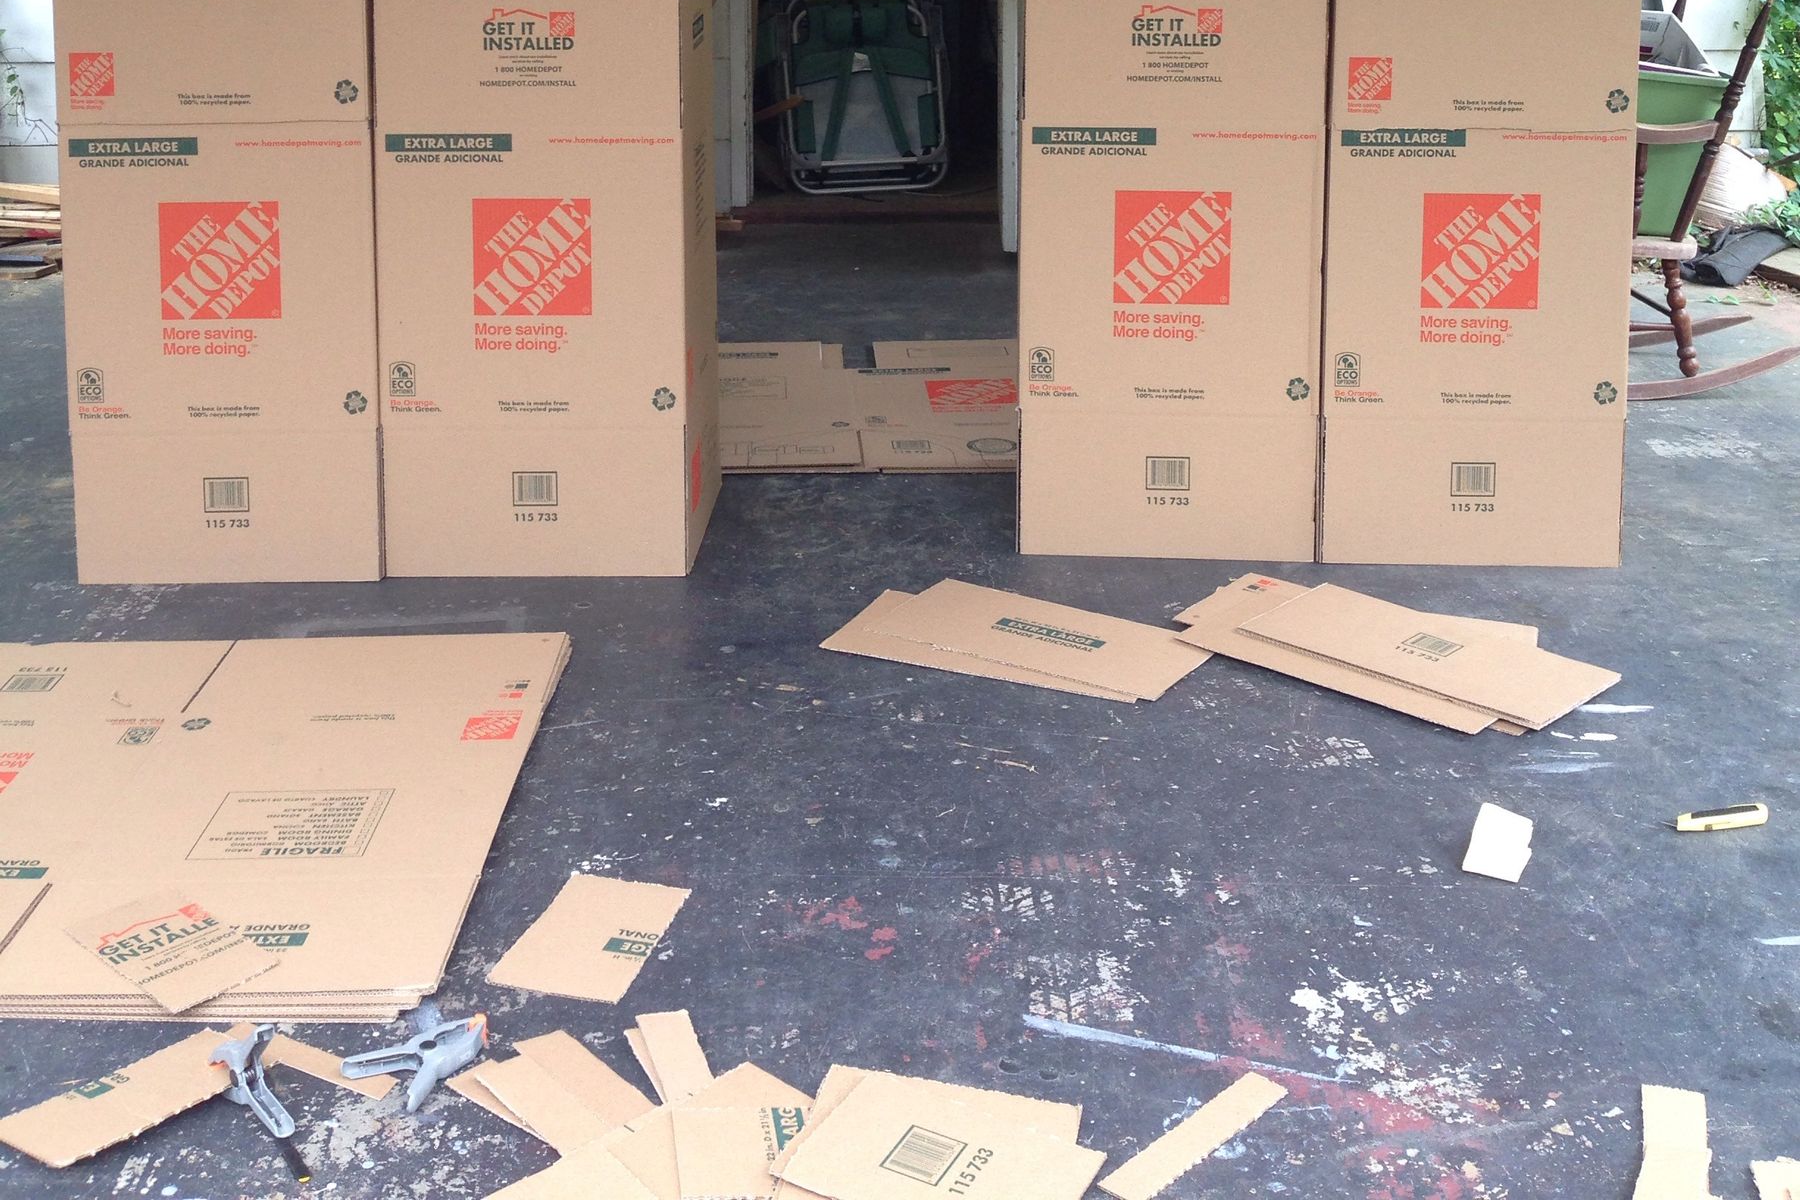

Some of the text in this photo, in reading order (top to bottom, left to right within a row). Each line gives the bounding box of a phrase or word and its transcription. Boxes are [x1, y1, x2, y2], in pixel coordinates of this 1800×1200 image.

[483, 22, 534, 35] GET IT
[1132, 19, 1183, 31] GET IT
[483, 38, 574, 50] INSTALLED
[1132, 34, 1221, 46] INSTALLED
[405, 138, 492, 149] EXTRA LARGE
[1051, 131, 1137, 142] EXTRA LARGE
[1360, 133, 1447, 143] EXTRA LARGE
[89, 141, 178, 153] EXTRA LARGE
[1042, 147, 1147, 155] GRANDE ADICIONAL
[1350, 149, 1394, 158] GRANDE
[79, 158, 189, 168] GRANDE ADICIONAL
[395, 154, 503, 163] GRANDE ADICIONAL
[1125, 202, 1174, 248] THE
[1434, 205, 1484, 251] THE
[170, 214, 220, 262] THE
[484, 210, 533, 257] THE
[1114, 191, 1232, 303] HOME
[1421, 193, 1541, 308] HOME
[162, 201, 279, 319] HOME
[474, 199, 591, 315] HOME
[1159, 233, 1231, 304] DEPOT
[1467, 237, 1540, 309] DEPOT
[209, 245, 280, 319] DEPOT
[520, 242, 591, 315] DEPOT
[1114, 311, 1204, 326] More saving.
[1420, 316, 1512, 331] More saving.
[163, 328, 256, 342] More saving.
[475, 323, 567, 338] More saving.
[1113, 326, 1197, 341] More doing.
[475, 338, 560, 353] More doing.
[1420, 331, 1505, 346] More doing.
[163, 343, 250, 357] More doing.
[1031, 366, 1051, 374] ECO
[80, 387, 101, 396] ECO
[392, 380, 413, 388] ECO
[1147, 497, 1189, 505] 115 733
[1451, 503, 1470, 512] 115
[206, 519, 250, 528] 115 733
[538, 513, 558, 521] 733
[992, 626, 1033, 638] GRANDE
[1036, 636, 1093, 652] ADICIONAL
[1008, 621, 1047, 634] EXTRA
[1051, 631, 1094, 645] LARGE
[260, 847, 343, 856] FRAGILE
[99, 923, 170, 956] GET IT
[108, 918, 219, 964] INSTALLE
[949, 1148, 993, 1195] 115 733
